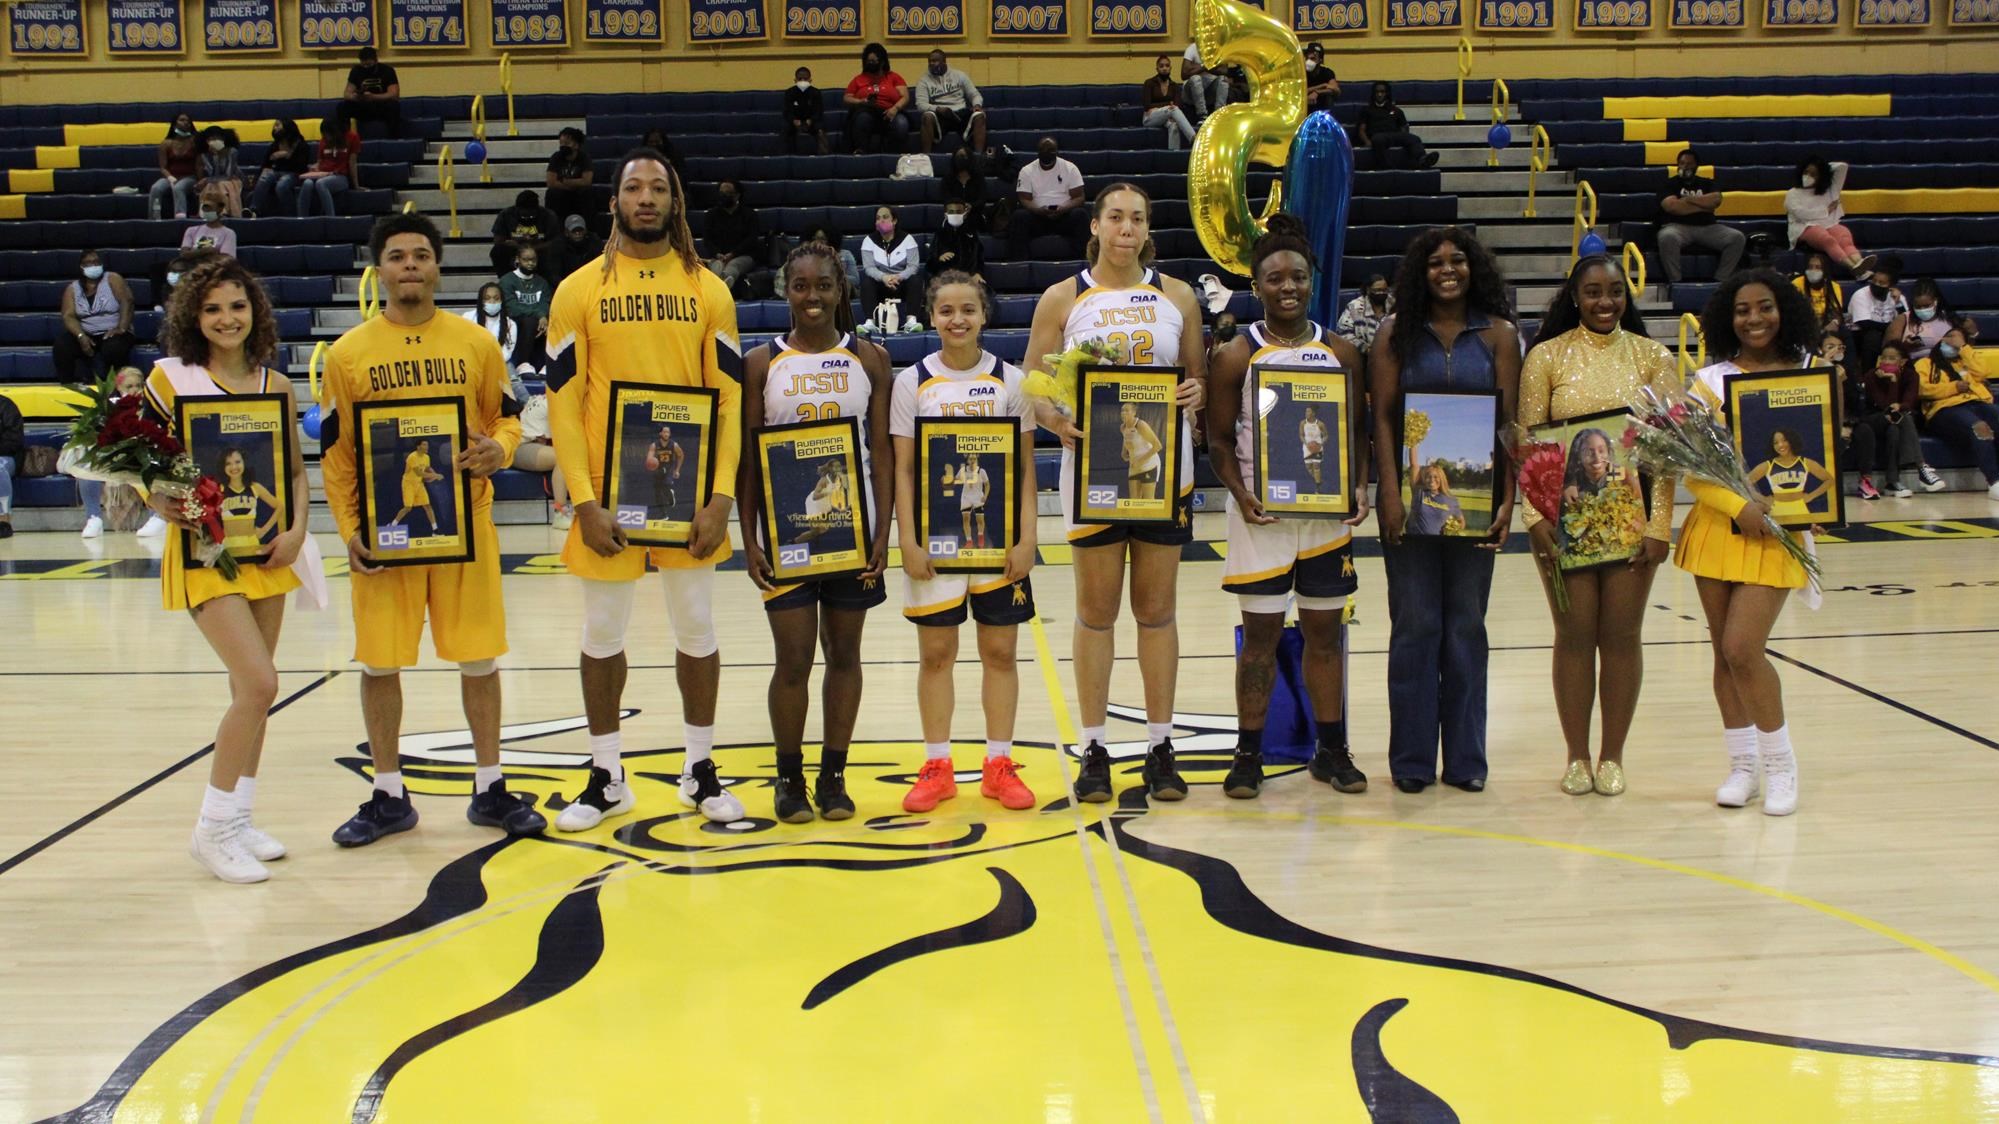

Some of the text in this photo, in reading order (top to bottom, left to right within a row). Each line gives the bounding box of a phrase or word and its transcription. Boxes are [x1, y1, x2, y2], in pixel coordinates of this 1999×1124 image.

[15, 10, 77, 20] RUNNER-UP
[112, 8, 175, 18] RUNNER-UP
[210, 6, 269, 17] RUNNER-UP
[304, 2, 366, 13] RUNNER-UP
[891, 6, 958, 30] 2006
[995, 6, 1063, 30] 2007
[1095, 5, 1162, 30] 2008
[1298, 3, 1364, 29] 1960
[1392, 1, 1457, 26] 1987
[1484, 2, 1548, 26] 1991
[1582, 2, 1647, 25] 1992
[1676, 0, 1740, 25] 1995
[1860, 0, 1926, 23] 2002
[303, 16, 370, 43] 2006
[394, 16, 462, 42] 1974
[495, 15, 563, 41] 1982
[589, 10, 657, 35] 1992
[693, 9, 760, 36] 2001
[788, 7, 856, 32] 2002
[14, 24, 80, 49] 1992
[112, 22, 177, 48] 1998
[207, 20, 274, 46] 2002
[600, 294, 698, 323] GOLDEN BULLS
[1094, 306, 1156, 328] JCSU
[370, 358, 466, 392] GOLDEN BULLS
[822, 360, 850, 368] CIAA
[784, 372, 848, 396] JCSU
[969, 387, 995, 396] CIAA
[1770, 388, 1807, 397] TAYLOR
[654, 404, 688, 412] XAVIER
[940, 400, 994, 417] JCSU
[1771, 395, 1822, 405] HUDSON
[223, 421, 278, 431] JOHNSON
[653, 412, 690, 421] JONES
[401, 425, 439, 435] JONES
[797, 437, 843, 448] AUBRIANA
[798, 445, 844, 456] BONNER
[1088, 491, 1115, 504] 32
[617, 510, 646, 525] 23
[378, 531, 407, 546] 05
[929, 541, 956, 554] 00
[780, 549, 808, 565] 20
